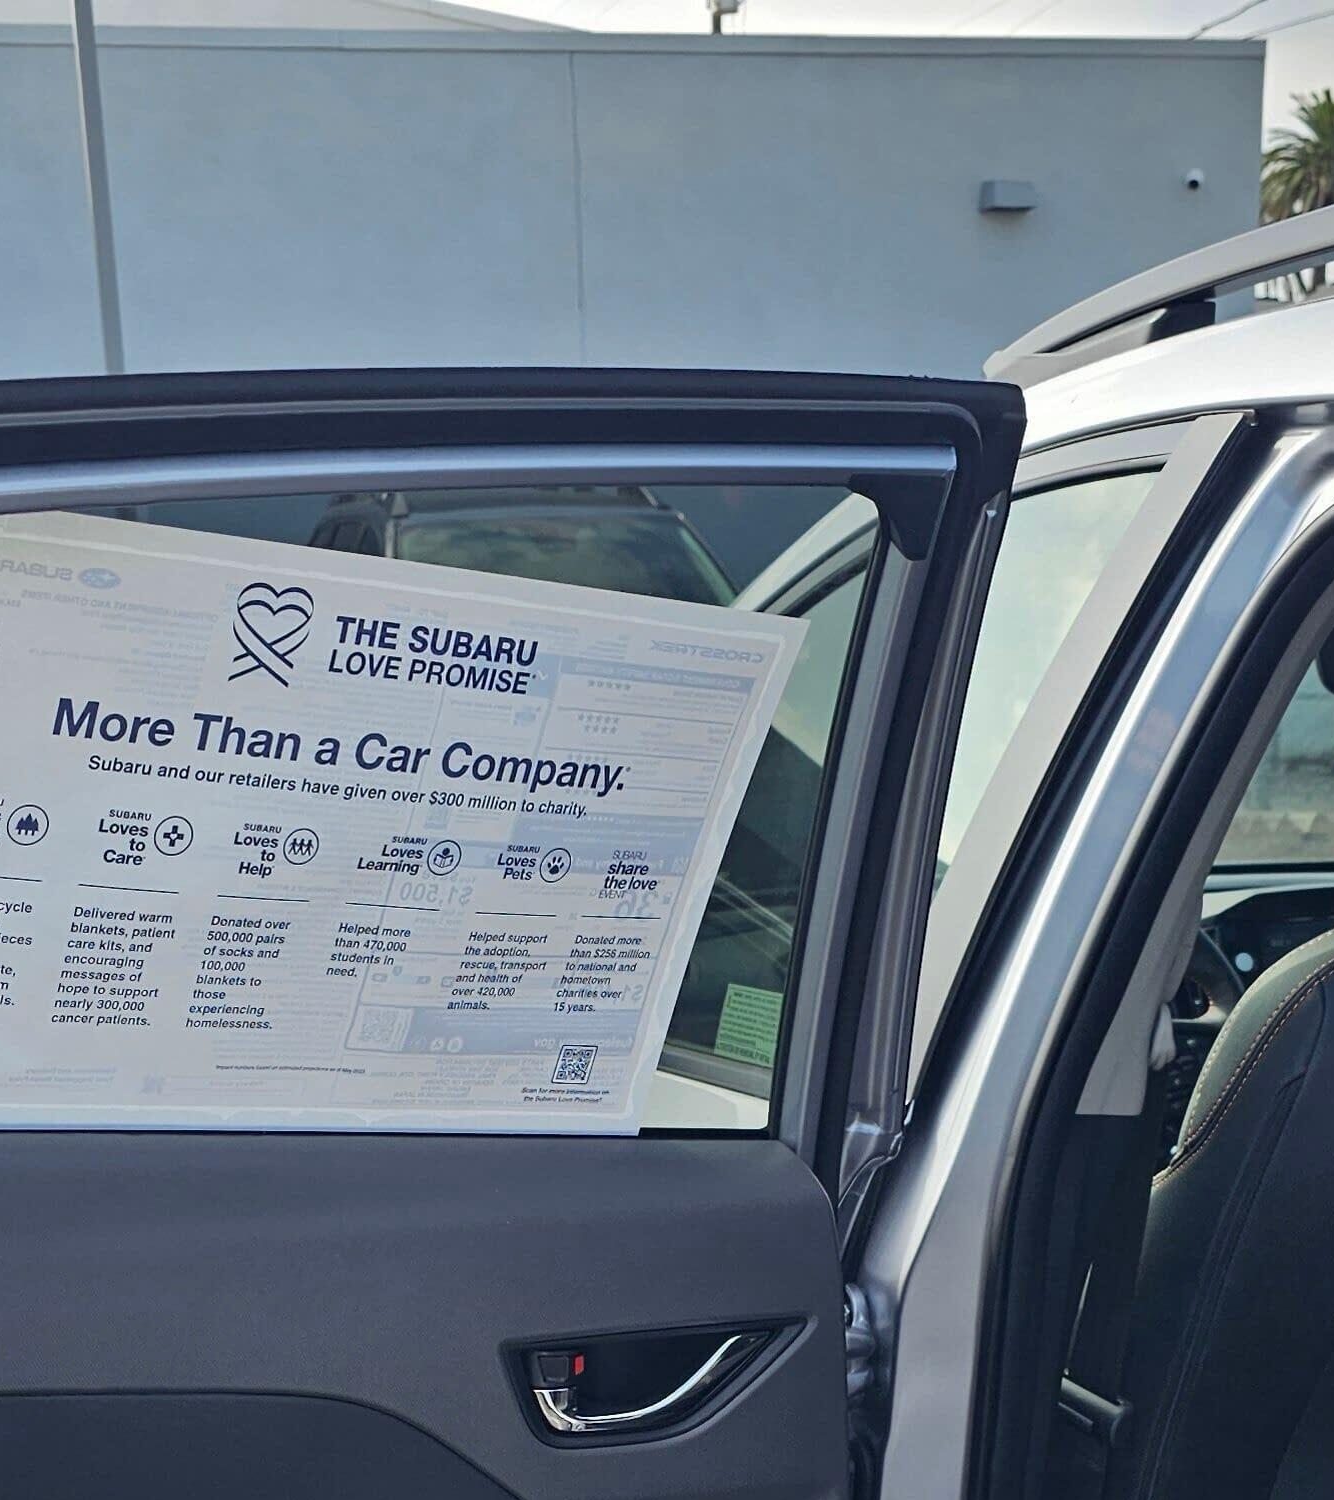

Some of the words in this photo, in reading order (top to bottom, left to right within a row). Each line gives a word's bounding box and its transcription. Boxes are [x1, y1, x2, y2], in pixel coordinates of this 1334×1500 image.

[336, 616, 400, 649] THE
[409, 626, 538, 669] SUBARU
[329, 649, 402, 679] LOVE
[408, 656, 531, 694] PROMISE
[53, 698, 174, 746] More
[194, 713, 300, 761] Than
[315, 738, 340, 765] a
[355, 733, 431, 773] Car
[89, 756, 151, 775] Subaru
[156, 764, 190, 780] and
[195, 770, 224, 783] our
[229, 773, 296, 791] retailers
[302, 778, 339, 795] have
[343, 784, 386, 800] given
[392, 791, 425, 803] over
[429, 791, 464, 807] $300
[468, 796, 516, 811] million
[521, 799, 534, 812] to
[539, 800, 586, 819] charity.
[109, 809, 151, 821] SUBARU
[99, 819, 148, 837] Loves
[244, 823, 282, 833] SUBARU
[130, 838, 145, 851] to
[234, 832, 279, 848] Loves
[392, 836, 427, 845] SUBARU
[382, 845, 424, 859] Loves
[507, 845, 540, 853] SUBARU
[612, 850, 647, 860] SUBARU
[104, 850, 142, 865] Care
[261, 850, 275, 862] to
[498, 853, 536, 867] Loves
[239, 862, 271, 878] Help
[357, 857, 420, 875] Learning
[608, 861, 649, 875] share
[503, 868, 532, 880] Pets
[604, 876, 627, 889] the
[628, 876, 657, 890] love
[598, 890, 624, 899] EVENT
[74, 907, 135, 920] Delivered
[139, 914, 172, 923] warm
[211, 916, 262, 928] Donated
[265, 921, 290, 929] over
[71, 922, 127, 937] blankets,
[132, 928, 175, 939] patient
[339, 923, 379, 936] Helped
[382, 929, 410, 937] more
[207, 931, 253, 942] 500,000
[255, 934, 285, 945] pairs
[469, 932, 506, 944] Helped
[507, 935, 547, 945] support
[575, 935, 616, 944] Donated
[68, 940, 95, 949] care
[99, 940, 124, 953] kits,
[129, 943, 153, 952] and
[335, 938, 360, 948] than
[363, 940, 406, 952] 470,000
[465, 946, 481, 955] the
[204, 946, 217, 955] of
[219, 948, 254, 957] socks
[257, 949, 280, 958] and
[570, 949, 591, 958] than
[594, 949, 617, 958] $256
[617, 950, 650, 959] million
[65, 956, 144, 969] encouraging
[330, 953, 380, 964] students
[384, 955, 394, 965] in
[201, 961, 245, 971] 100,000
[461, 962, 497, 971] rescue,
[500, 961, 546, 972] transport
[565, 962, 575, 970] to
[577, 963, 617, 971] national
[618, 963, 637, 972] and
[61, 971, 125, 982] messages
[130, 972, 142, 982] of
[326, 968, 357, 977] need.
[456, 973, 476, 982] and
[478, 974, 509, 983] health
[512, 975, 522, 983] of
[196, 975, 246, 985] blankets
[250, 977, 261, 986] to
[560, 975, 611, 985] hometown
[58, 983, 89, 995] hope
[94, 986, 105, 994] to
[109, 988, 158, 999] support
[193, 989, 225, 999] those
[477, 987, 515, 997] 420,000
[557, 989, 598, 998] charities
[55, 999, 93, 1011] nearly
[97, 1000, 144, 1011] 300,000
[189, 1004, 264, 1017] experiencing
[447, 1000, 490, 1010] animals.
[555, 1002, 565, 1011] 15
[567, 1004, 596, 1014] years.
[52, 1015, 94, 1023] cancer
[97, 1015, 150, 1026] patients.
[186, 1018, 272, 1029] homelessness.
